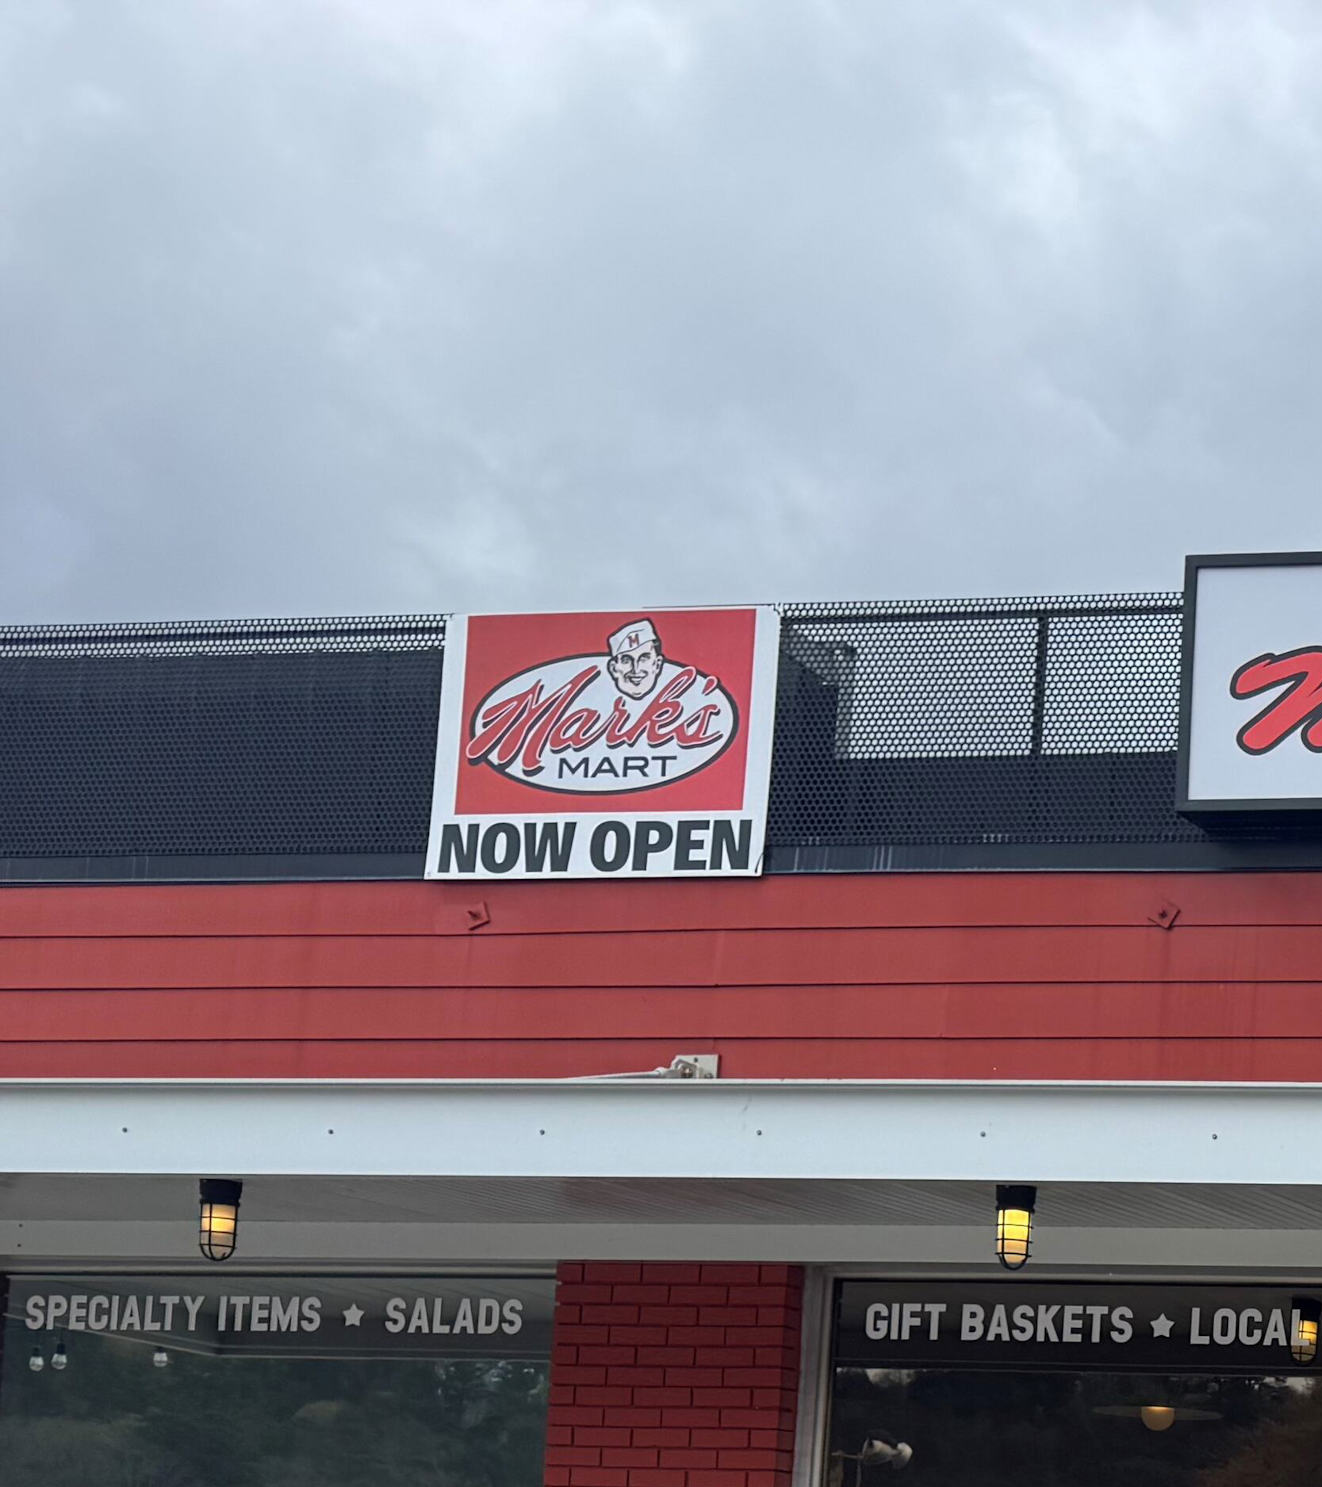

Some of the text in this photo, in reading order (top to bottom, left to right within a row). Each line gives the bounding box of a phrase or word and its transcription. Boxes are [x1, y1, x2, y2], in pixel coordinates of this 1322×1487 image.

[466, 664, 723, 776] Mark's
[558, 755, 677, 779] MART
[437, 819, 752, 874] NOW OPEN
[25, 1295, 523, 1335] SPECIALTY ITEMS SALADS
[864, 1303, 946, 1340] GIFT
[961, 1304, 1134, 1343] BASKETS
[1189, 1307, 1312, 1347] LOCAL
